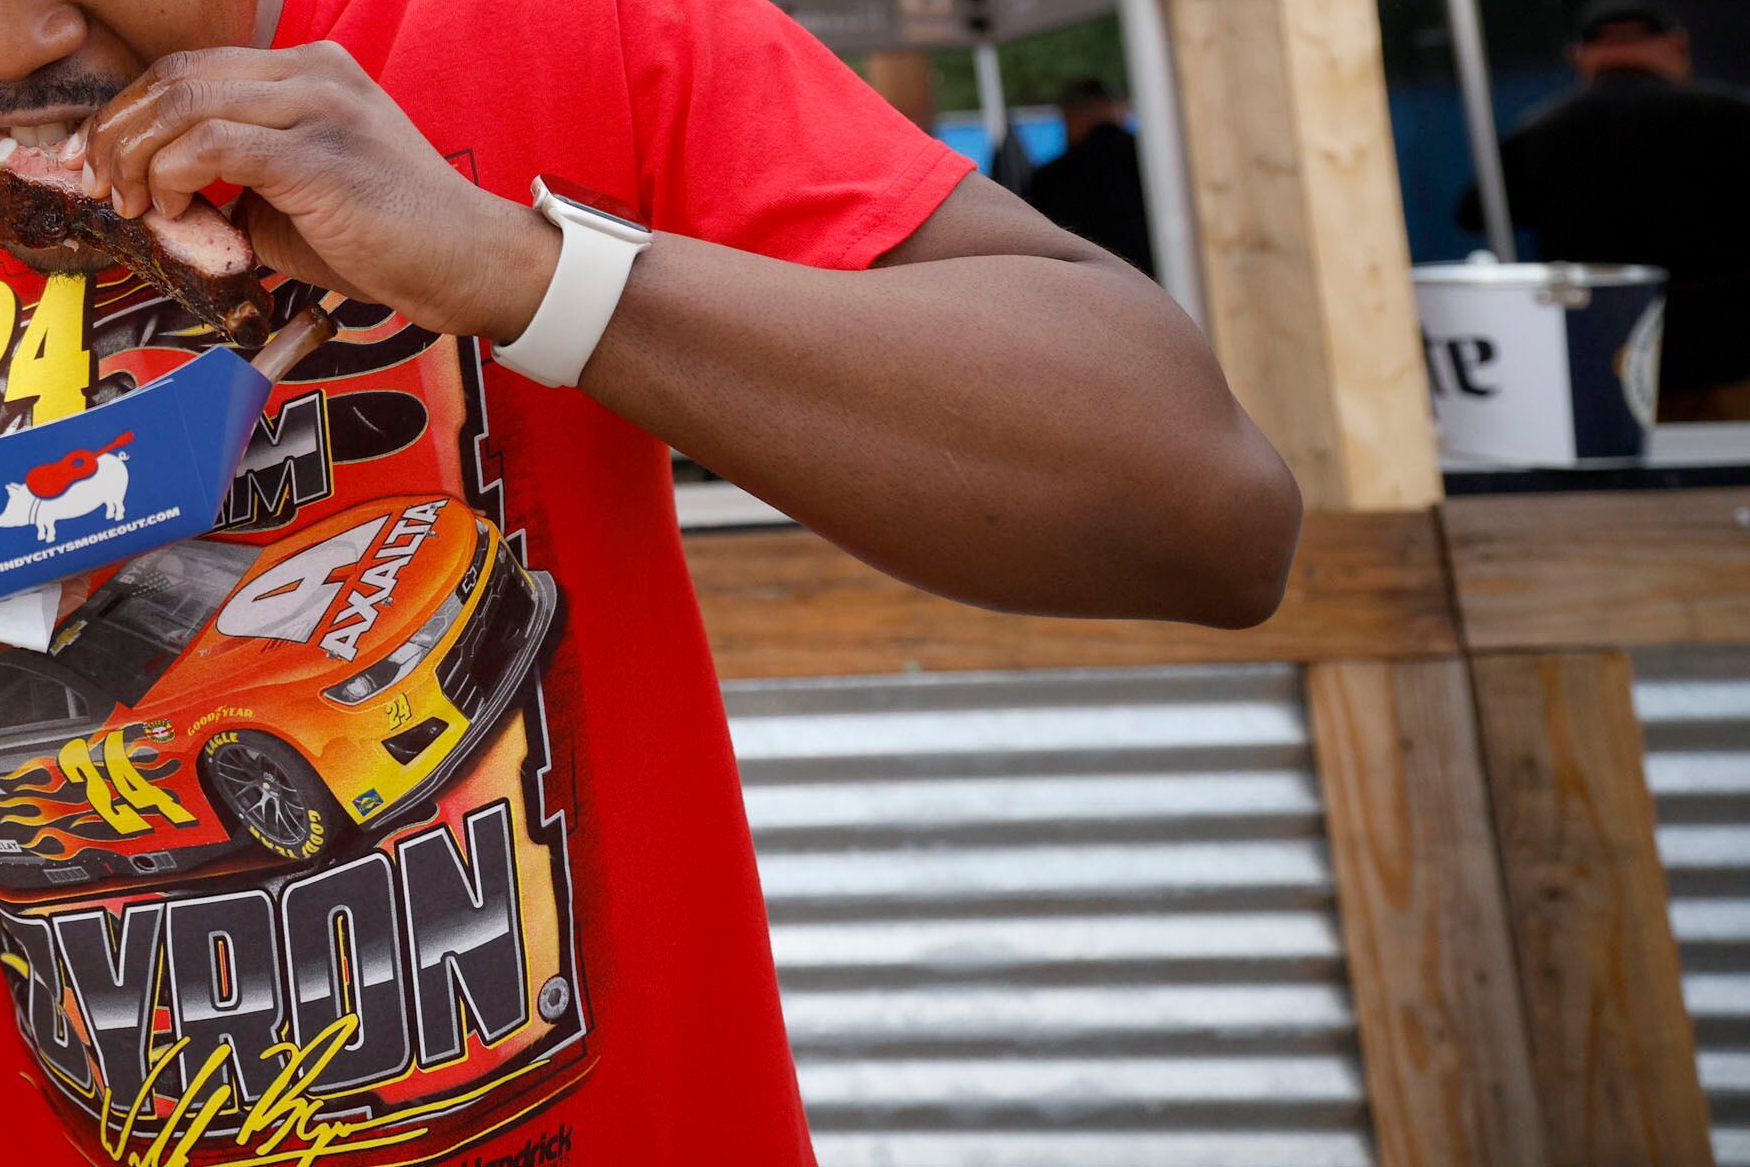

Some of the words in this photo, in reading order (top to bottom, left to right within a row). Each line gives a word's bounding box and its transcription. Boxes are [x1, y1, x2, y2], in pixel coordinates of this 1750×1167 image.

[318, 498, 450, 663] AXALTA
[187, 705, 253, 737] GOODYEAR
[58, 730, 197, 835] 24
